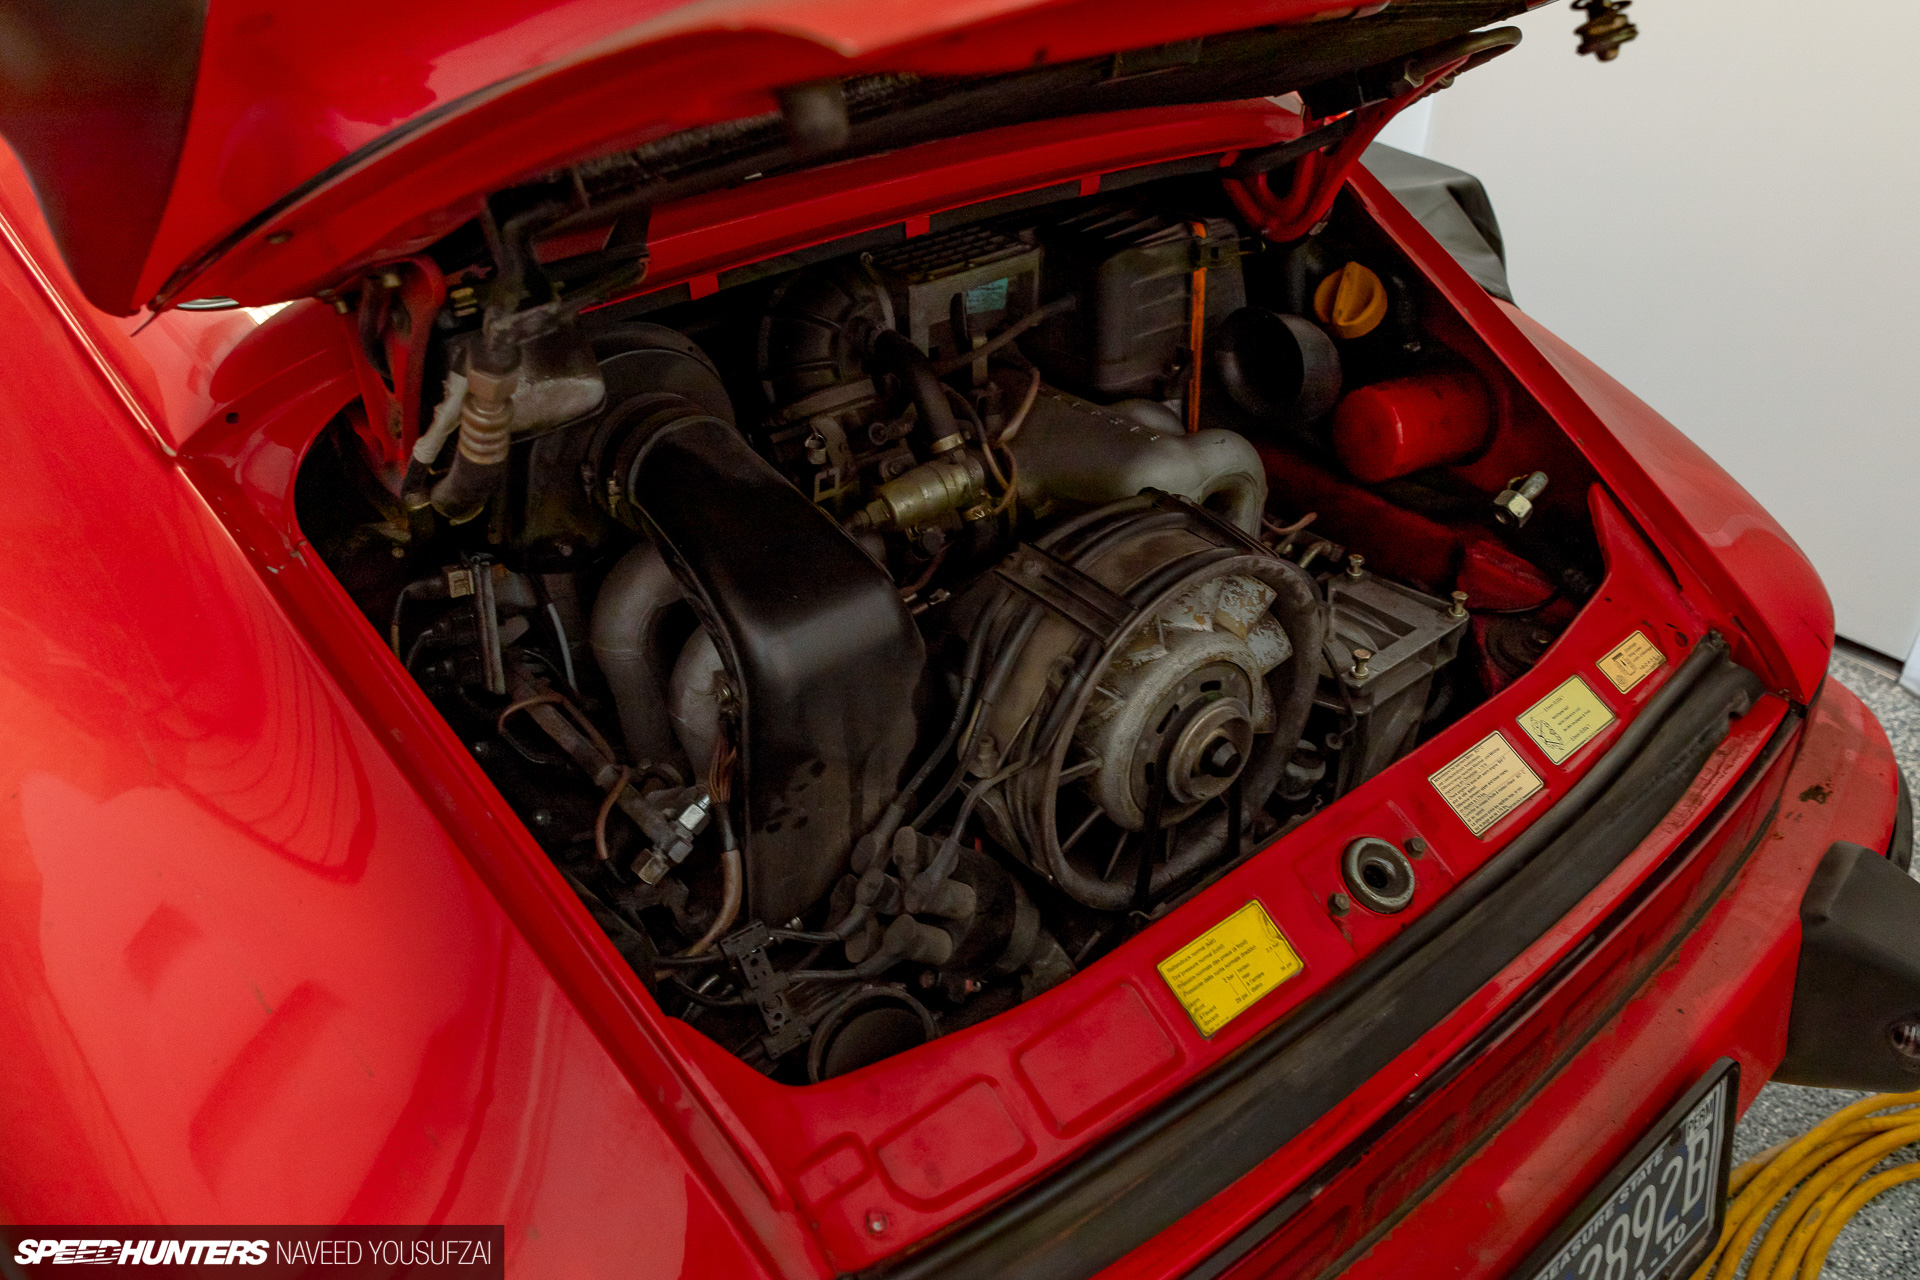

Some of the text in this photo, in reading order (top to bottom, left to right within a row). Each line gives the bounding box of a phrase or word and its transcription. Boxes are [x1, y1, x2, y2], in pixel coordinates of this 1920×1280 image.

[1180, 961, 1199, 977] pressure
[1198, 951, 1213, 964] normal
[1620, 1149, 1664, 1204] STATE
